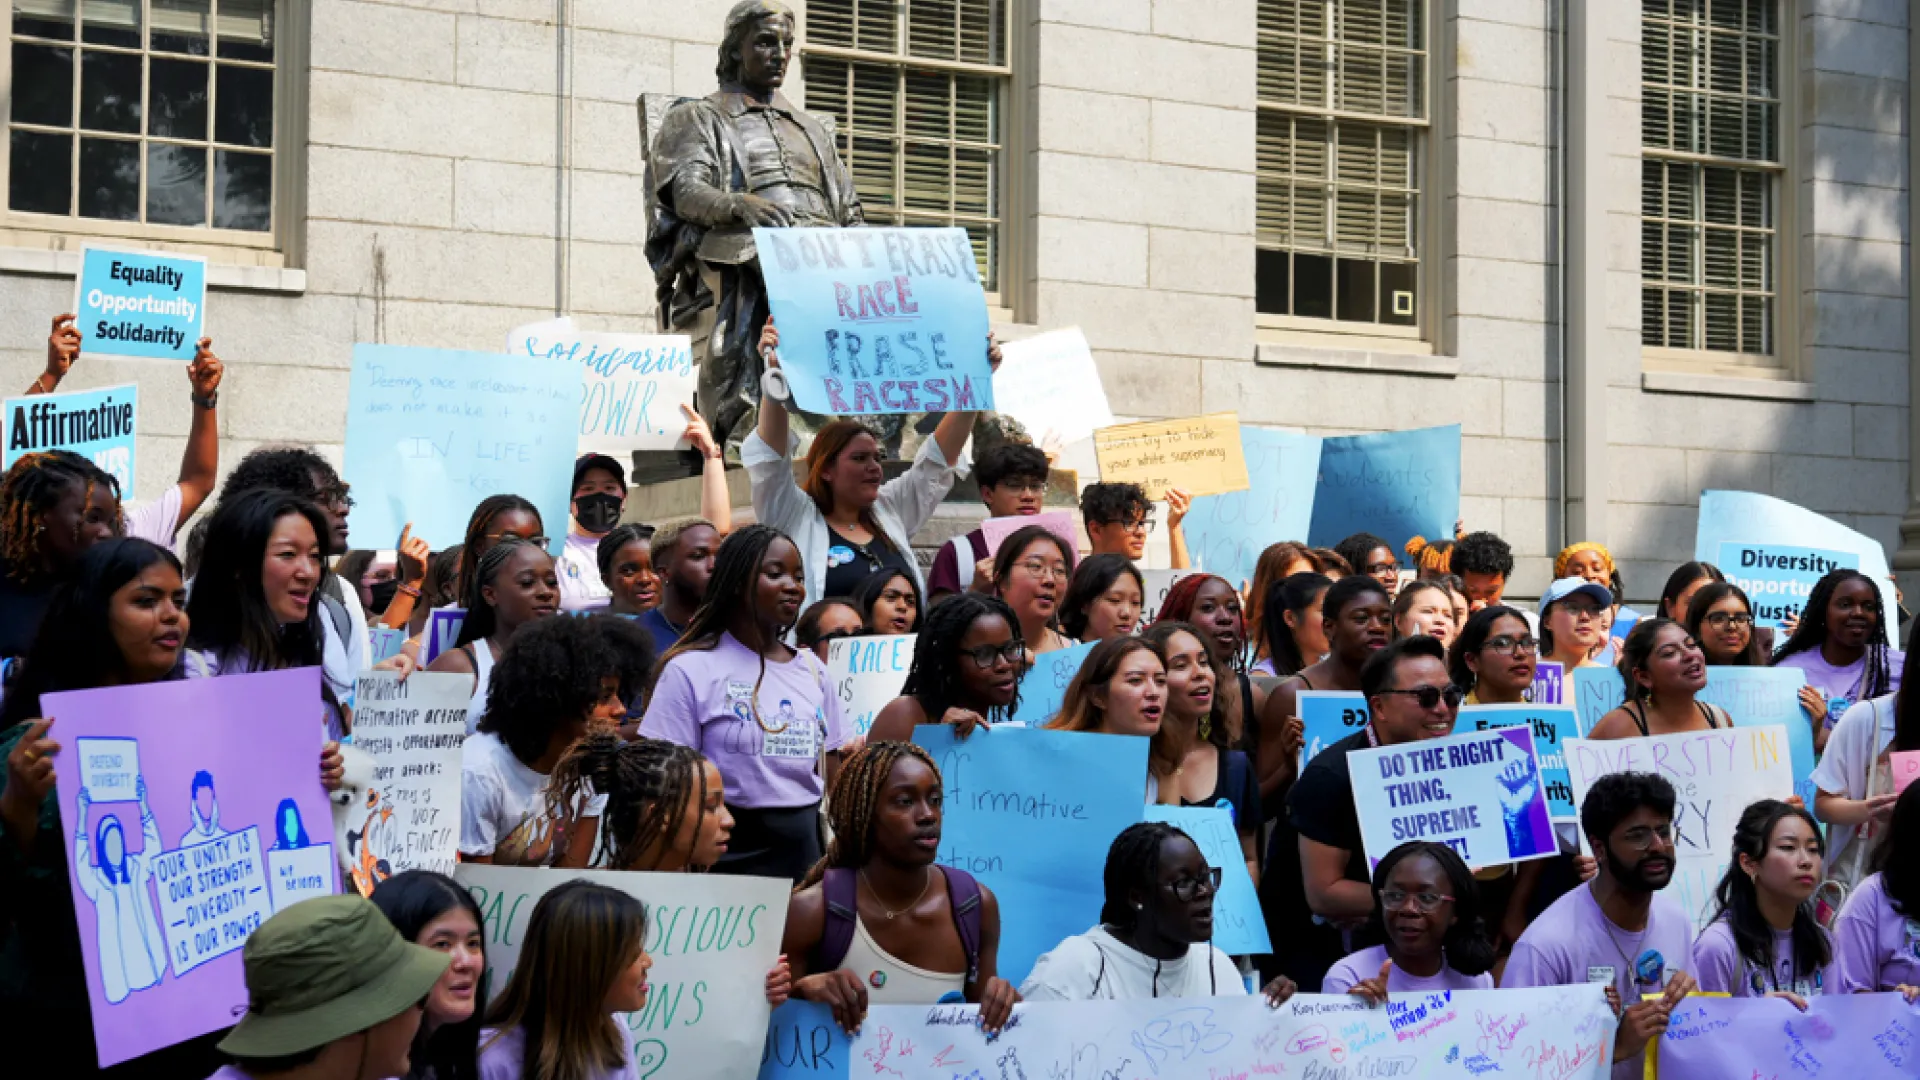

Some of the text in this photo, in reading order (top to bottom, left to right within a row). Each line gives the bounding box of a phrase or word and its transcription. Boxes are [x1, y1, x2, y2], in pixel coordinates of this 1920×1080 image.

[110, 260, 183, 291] Equality
[769, 232, 978, 284] DON'T ERASE
[87, 288, 197, 323] Opportunity
[833, 275, 919, 319] RACE
[95, 320, 185, 350] Solidarity
[10, 396, 133, 451] Affirmative
[409, 430, 458, 459] IN
[1740, 549, 1837, 573] Diversity
[1723, 573, 1813, 597] Opportu
[1751, 601, 1799, 620] Justi
[848, 638, 906, 674] RACE
[839, 676, 853, 702] IS
[1476, 717, 1556, 744] Eity
[1378, 737, 1504, 779] DO THE RIGHT
[1752, 731, 1779, 771] IN
[1384, 778, 1452, 808] THING,
[1391, 805, 1481, 840] SUPREME
[158, 832, 250, 882] OUR UNITY IS
[169, 857, 254, 903] OUR STRENGTH
[175, 911, 262, 964] IS OUR POWER
